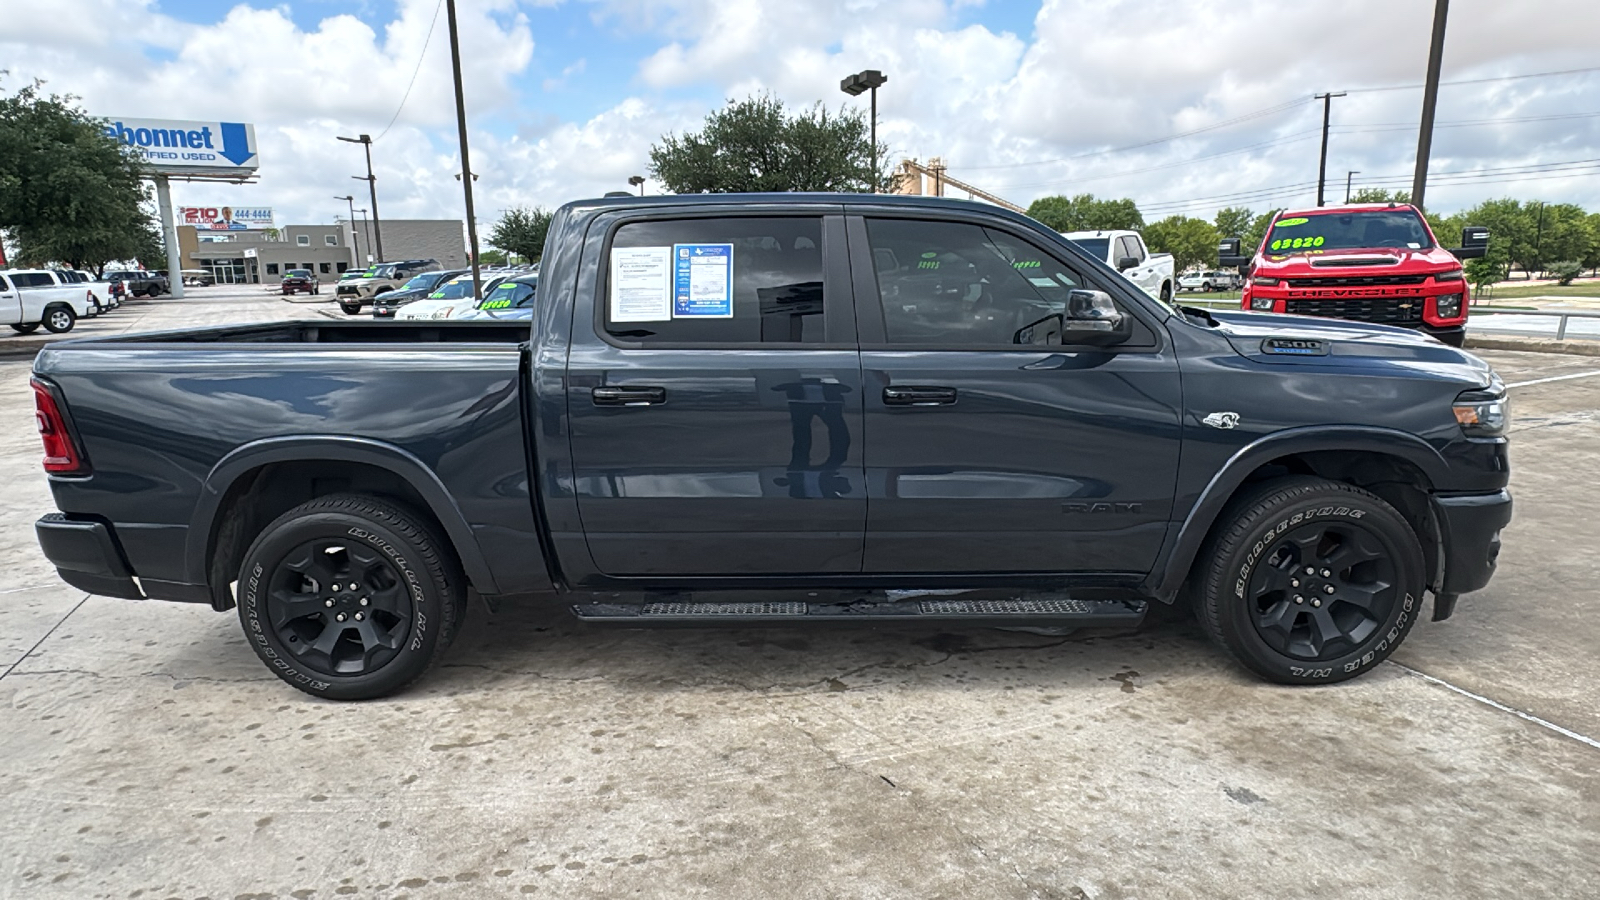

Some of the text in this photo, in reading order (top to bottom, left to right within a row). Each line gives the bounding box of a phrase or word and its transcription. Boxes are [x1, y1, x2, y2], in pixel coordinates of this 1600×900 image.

[181, 153, 216, 161] USED
[234, 209, 271, 218] 444-4444
[1271, 236, 1324, 250] 43820
[1288, 287, 1424, 298] CHEVROLET
[1271, 340, 1321, 348] 1500
[1061, 502, 1142, 514] RAM
[1235, 506, 1366, 599] BRIDGESTONE
[347, 526, 424, 602] DUELER
[246, 562, 332, 690] BRIDGESTONE
[1343, 592, 1414, 673] DUELER
